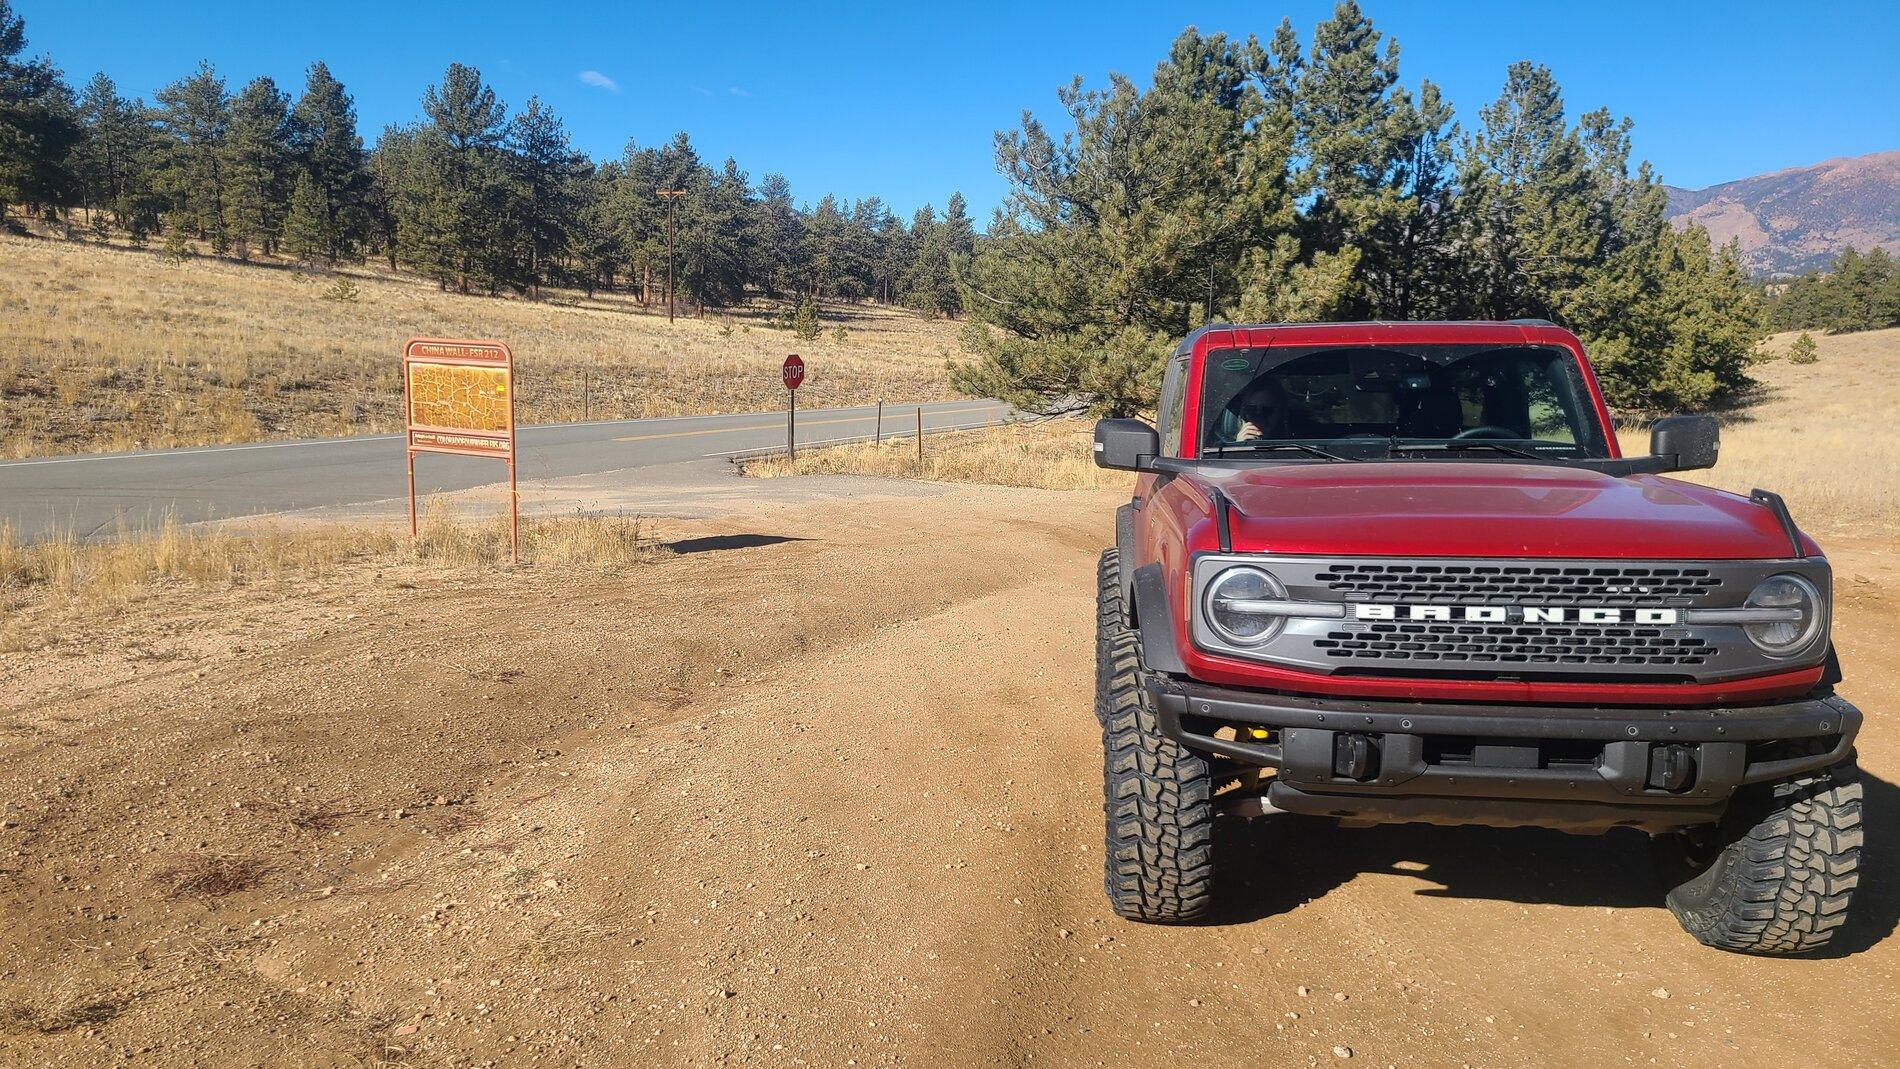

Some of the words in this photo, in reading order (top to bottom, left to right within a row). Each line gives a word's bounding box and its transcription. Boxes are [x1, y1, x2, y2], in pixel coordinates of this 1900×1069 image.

[421, 346, 444, 355] CHINA
[469, 348, 483, 358] FSR
[484, 349, 499, 359] 212
[784, 365, 803, 379] STOP
[1354, 602, 1677, 625] BRONCO
